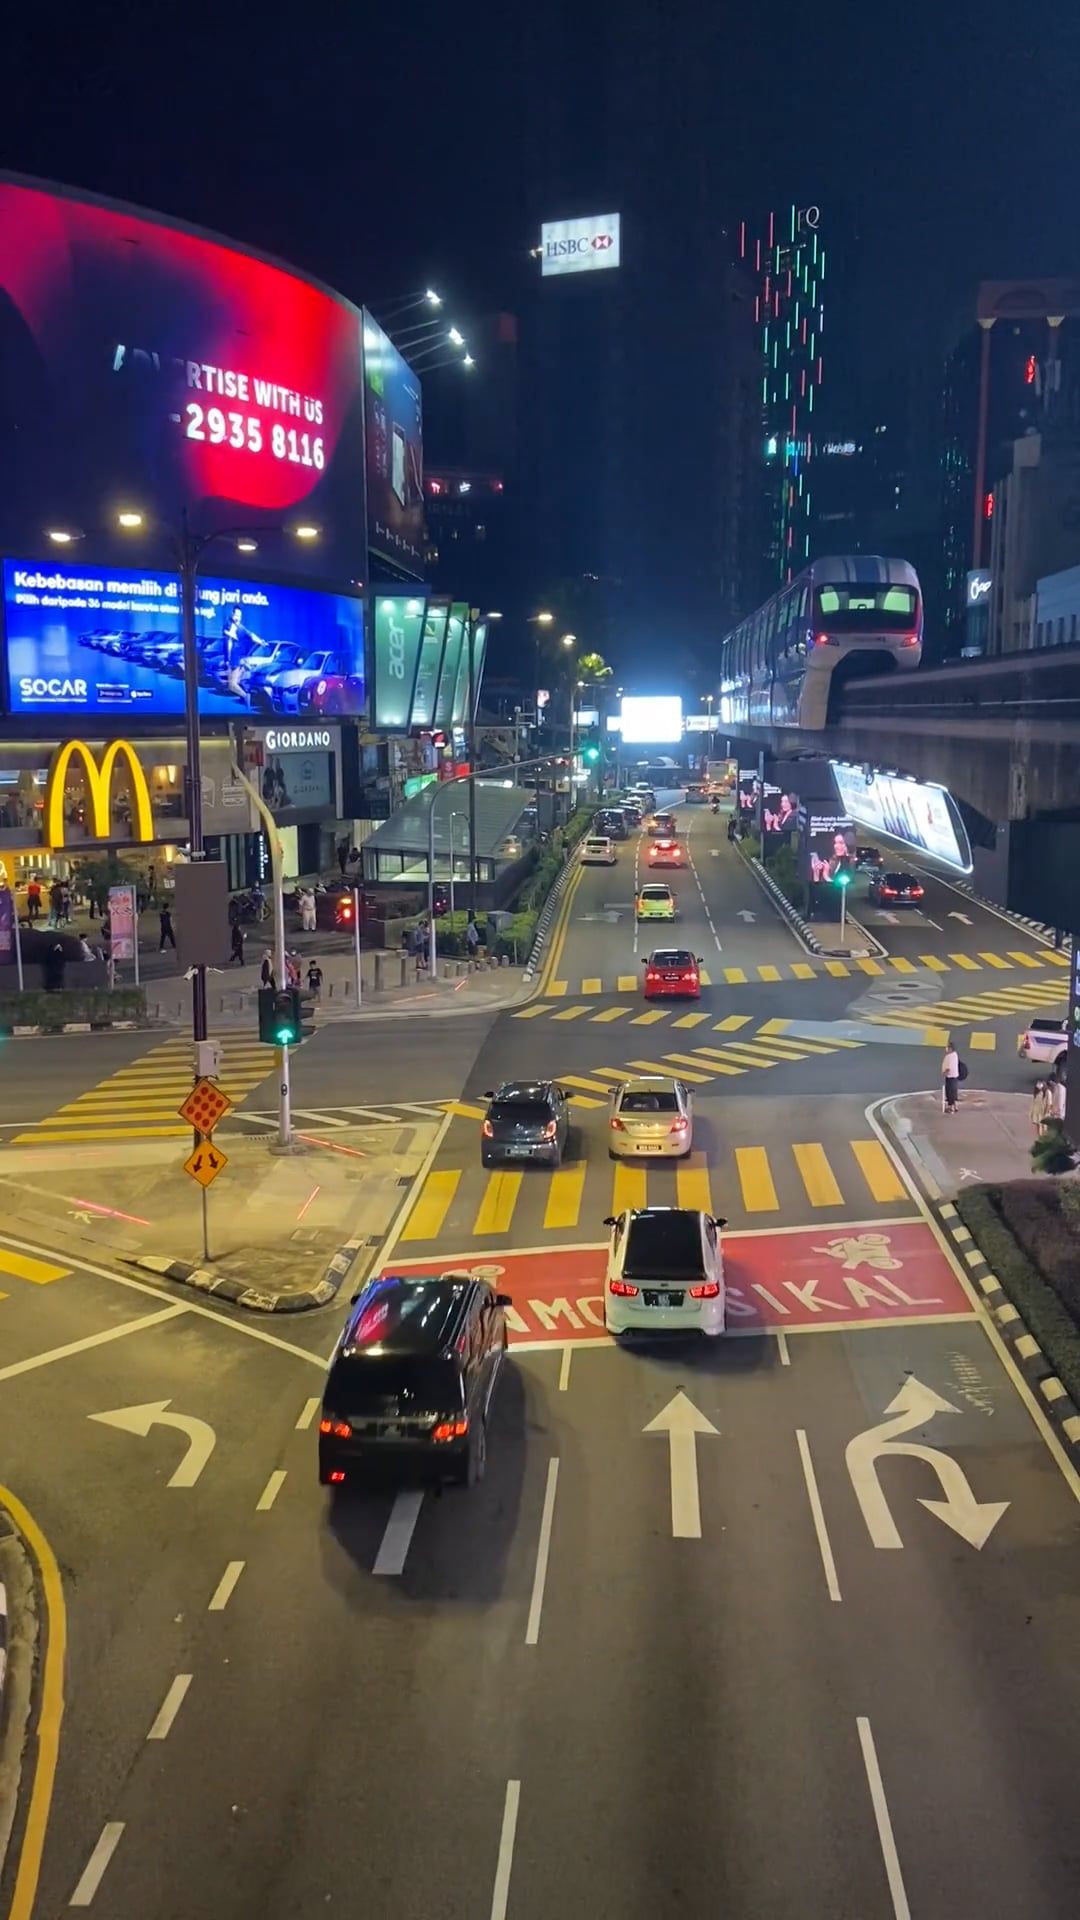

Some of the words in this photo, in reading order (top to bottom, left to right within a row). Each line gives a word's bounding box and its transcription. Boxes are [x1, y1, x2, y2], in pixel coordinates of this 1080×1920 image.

[546, 237, 589, 257] HSBC
[253, 378, 300, 418] WITH
[304, 396, 323, 425] US
[271, 424, 325, 470] 8116
[14, 571, 104, 592] Kebebasan
[107, 580, 162, 597] memilih
[164, 582, 177, 598] di
[221, 588, 240, 606] jari
[389, 616, 405, 680] acer
[20, 678, 87, 696] SOCAR
[266, 730, 330, 750] GIORDANO
